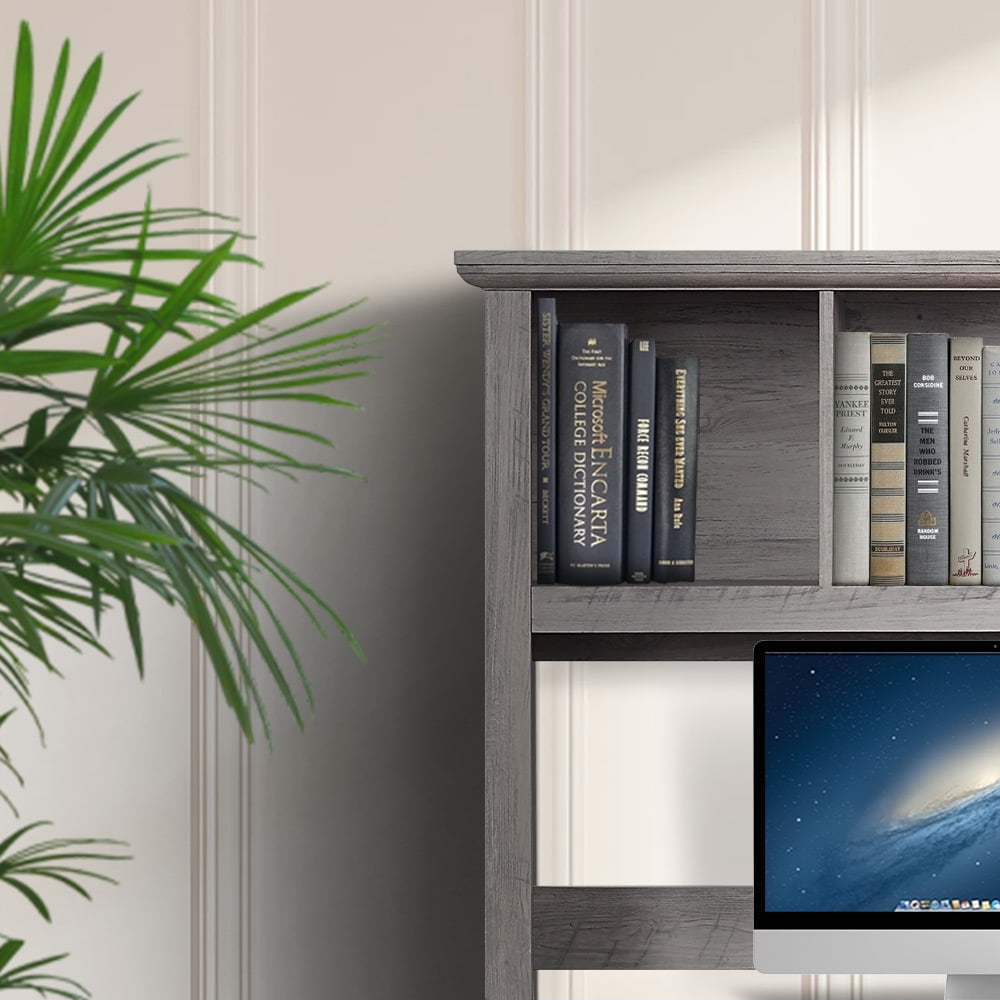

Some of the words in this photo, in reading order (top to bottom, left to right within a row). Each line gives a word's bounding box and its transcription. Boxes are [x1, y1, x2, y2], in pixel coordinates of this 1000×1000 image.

[542, 312, 552, 347] SISTER
[574, 381, 588, 447] COLLEGE
[592, 381, 608, 445] Microsoft
[834, 400, 870, 409] YANKEE
[836, 410, 868, 418] PRIEST
[880, 407, 897, 415] TOLD
[541, 399, 551, 438] GRAND
[637, 419, 651, 443] FORCE
[919, 437, 936, 446] MEN
[920, 427, 935, 435] THE
[541, 439, 551, 471] TOUR
[636, 445, 650, 470] RECON
[913, 458, 942, 466] ROBBED
[918, 447, 937, 456] WHO
[574, 452, 588, 547] DICTIONARY
[635, 473, 649, 513] COMMAND
